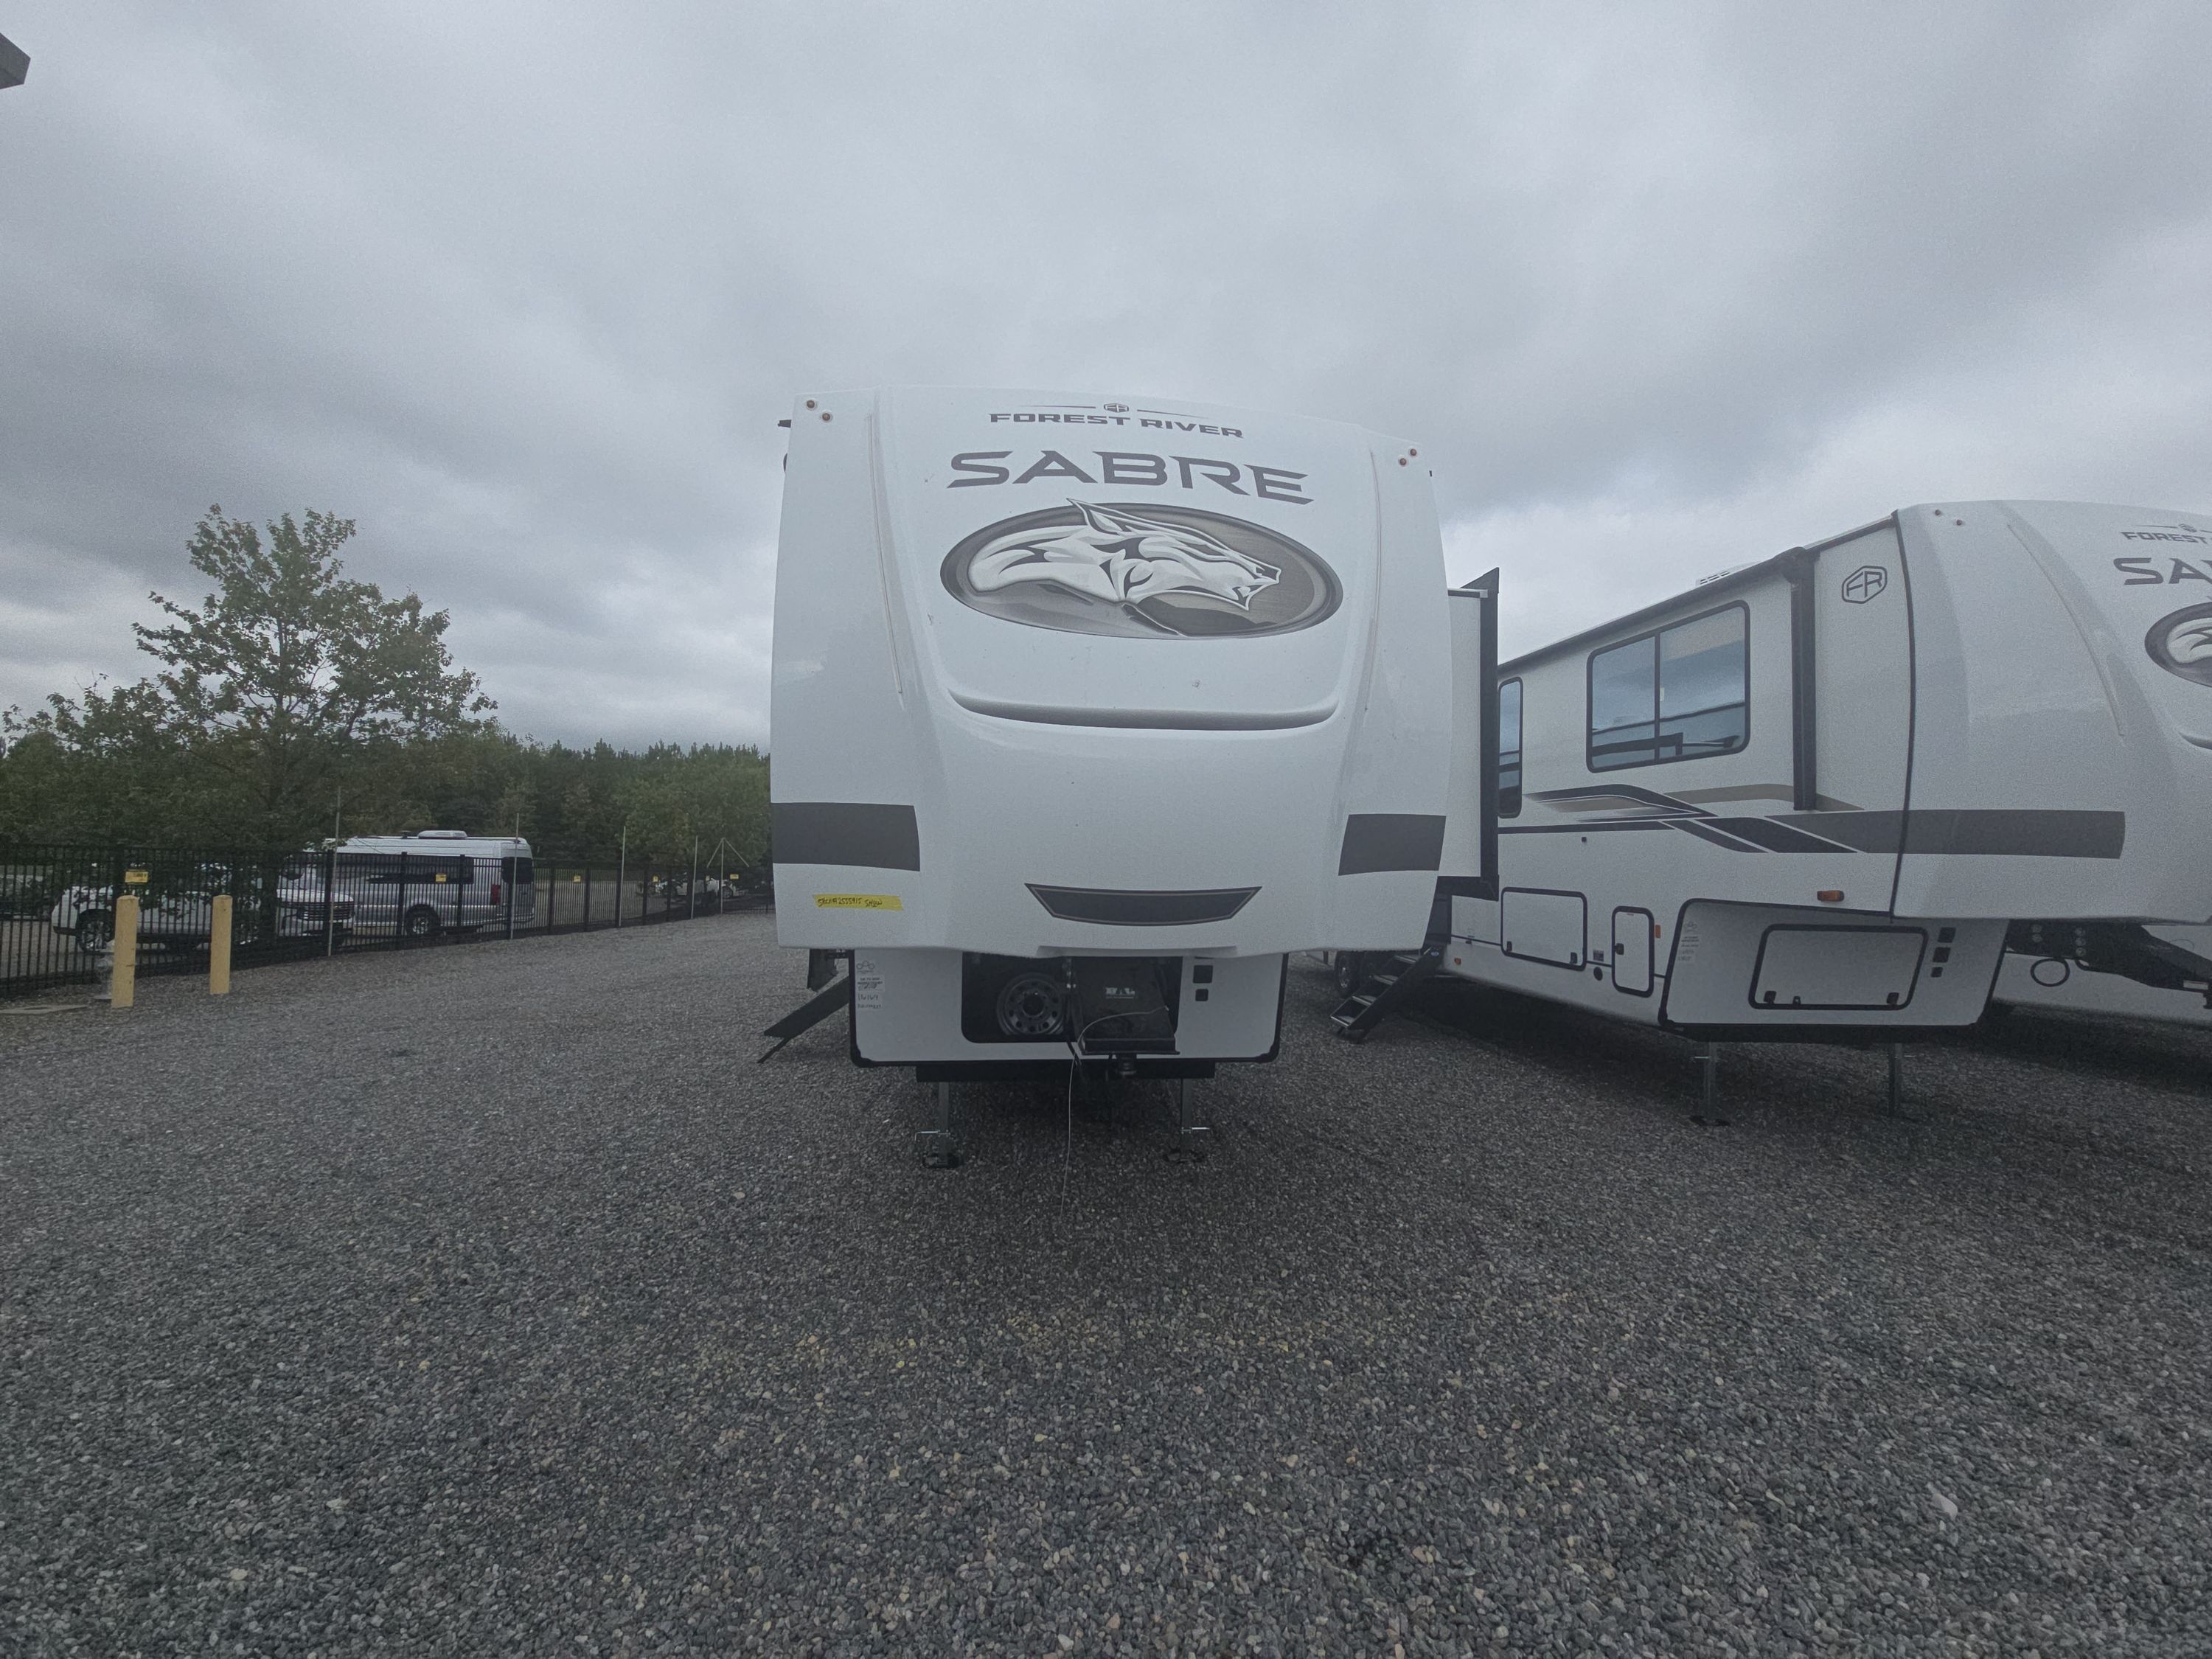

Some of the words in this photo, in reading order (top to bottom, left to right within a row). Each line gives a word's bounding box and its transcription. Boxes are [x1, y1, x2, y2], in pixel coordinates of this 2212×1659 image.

[988, 413, 1131, 425] FOREST
[1138, 418, 1245, 439] RIVER
[946, 450, 1315, 506] SABRE
[2121, 531, 2208, 545] FOREST
[1846, 570, 1882, 598] FR
[2113, 557, 2212, 586] SA
